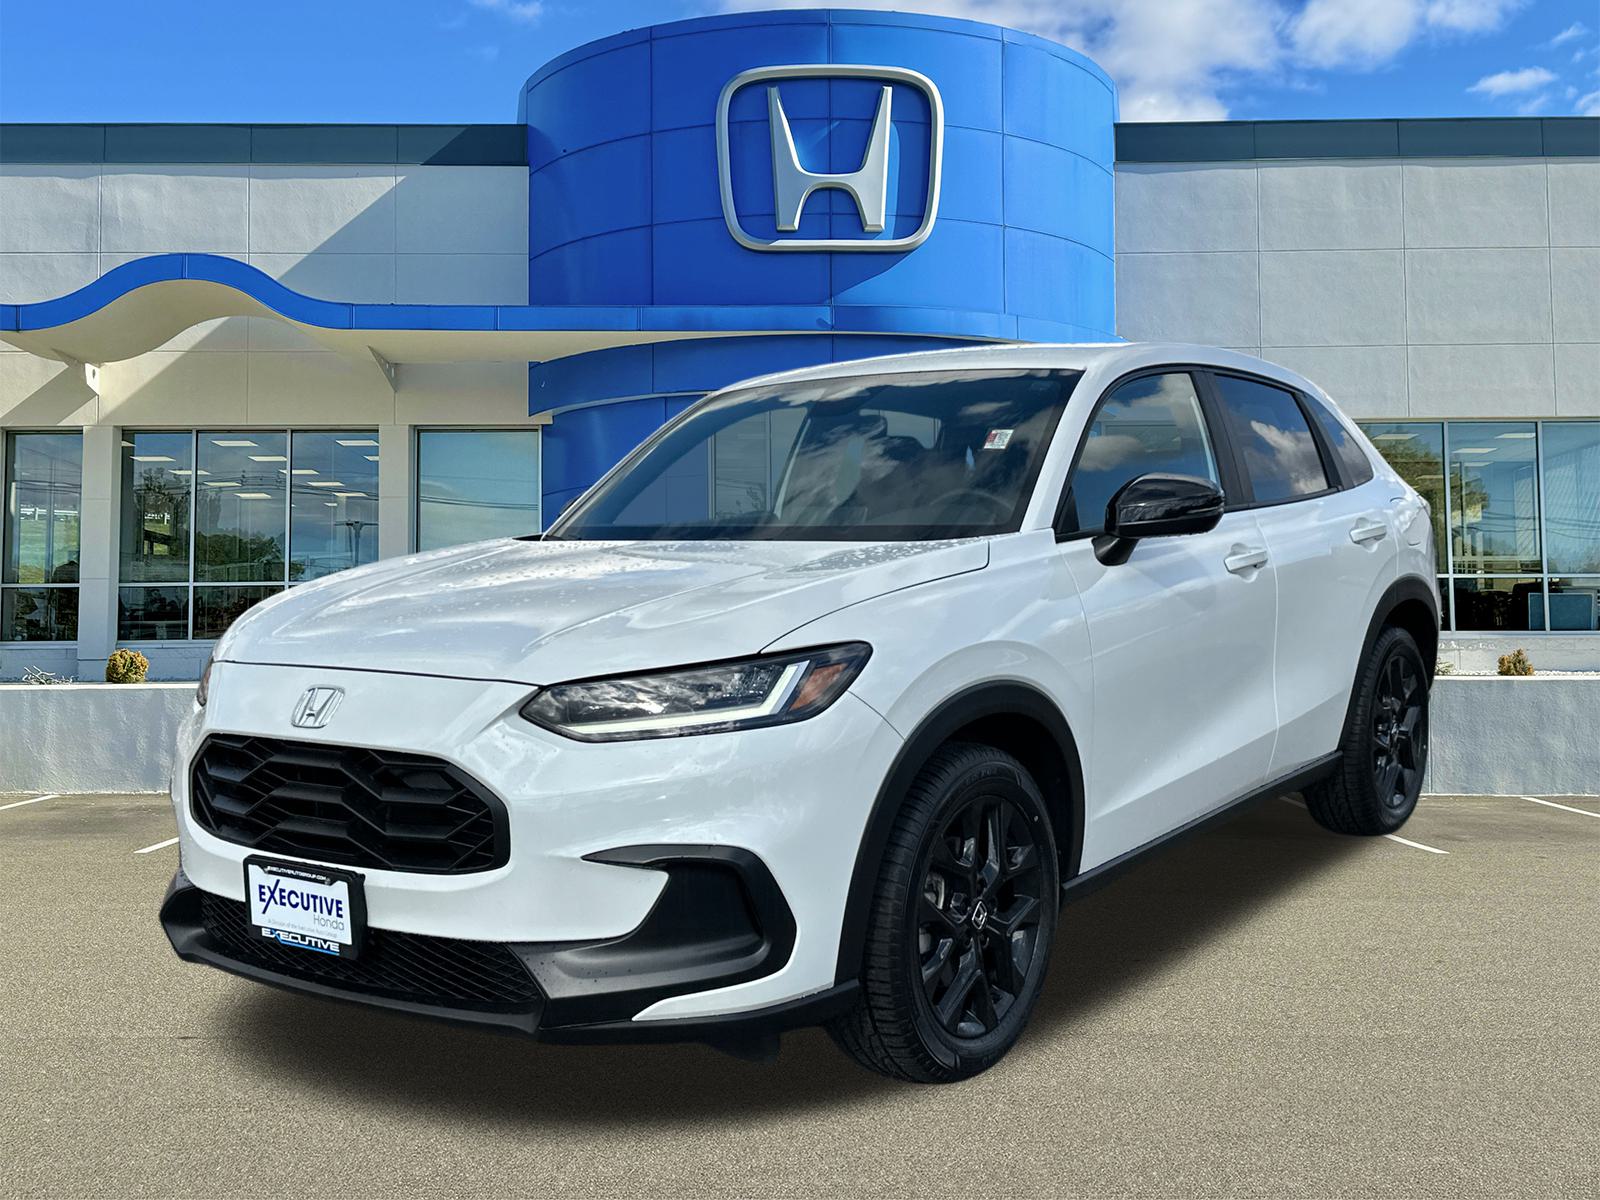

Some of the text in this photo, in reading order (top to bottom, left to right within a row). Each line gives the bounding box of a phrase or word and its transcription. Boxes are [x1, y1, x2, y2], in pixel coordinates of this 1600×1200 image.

[258, 879, 344, 919] EXECUTIVE
[313, 915, 345, 931] Honda
[261, 928, 340, 953] EXECUTIVE
